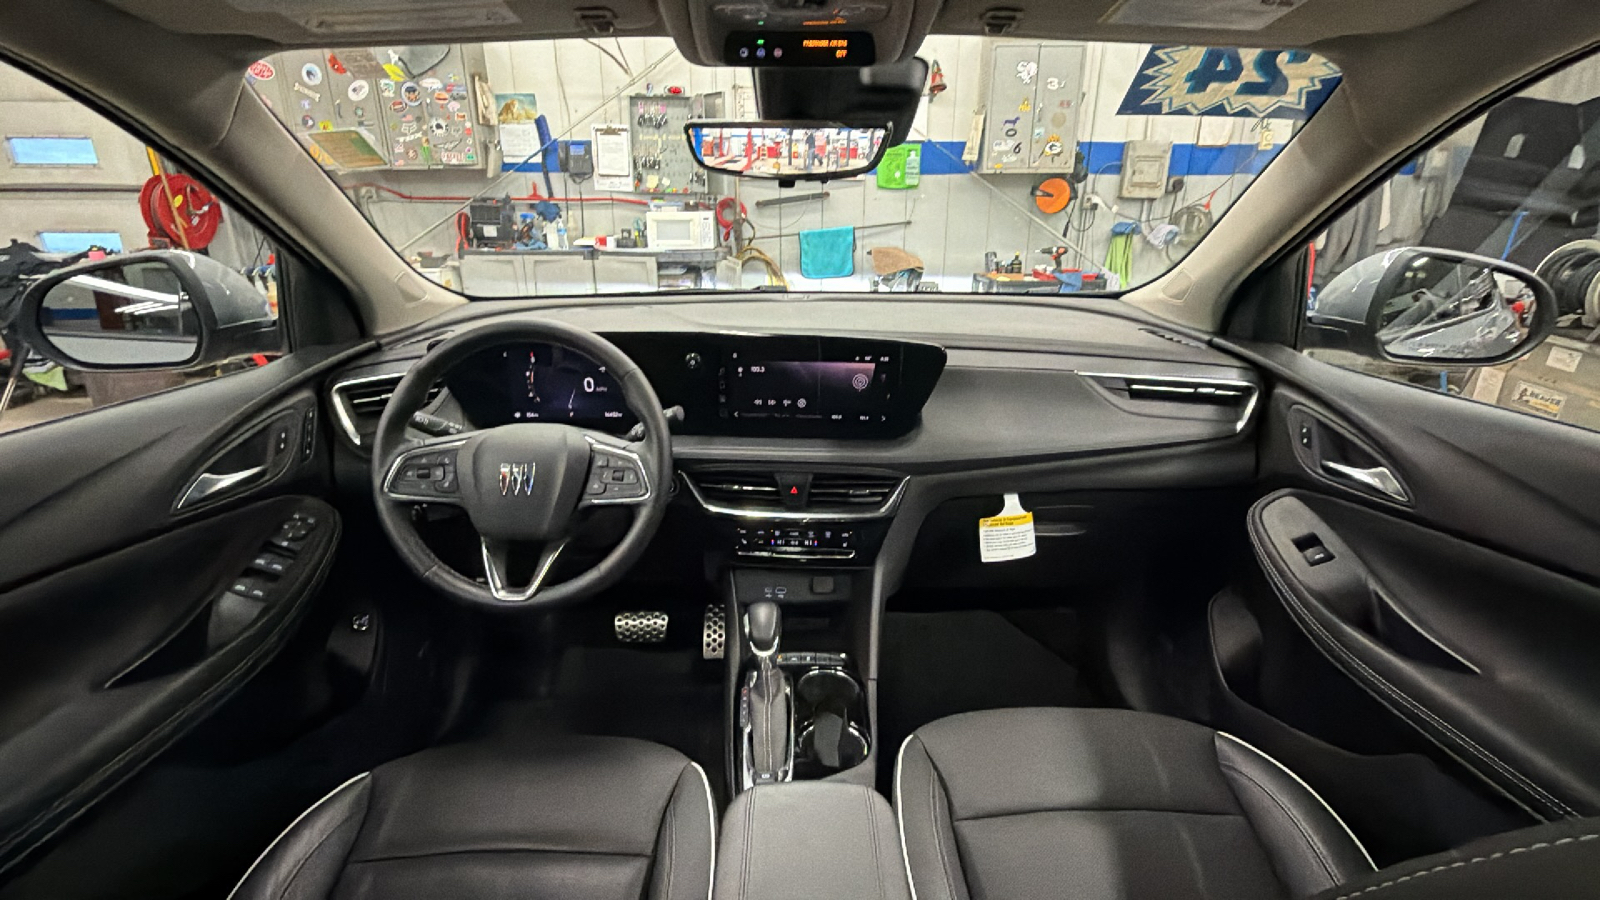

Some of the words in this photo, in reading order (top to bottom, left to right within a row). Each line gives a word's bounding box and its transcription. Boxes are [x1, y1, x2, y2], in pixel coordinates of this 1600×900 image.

[1013, 142, 1023, 154] 6
[583, 376, 595, 393] 0
[1529, 391, 1561, 405] BEAVER
